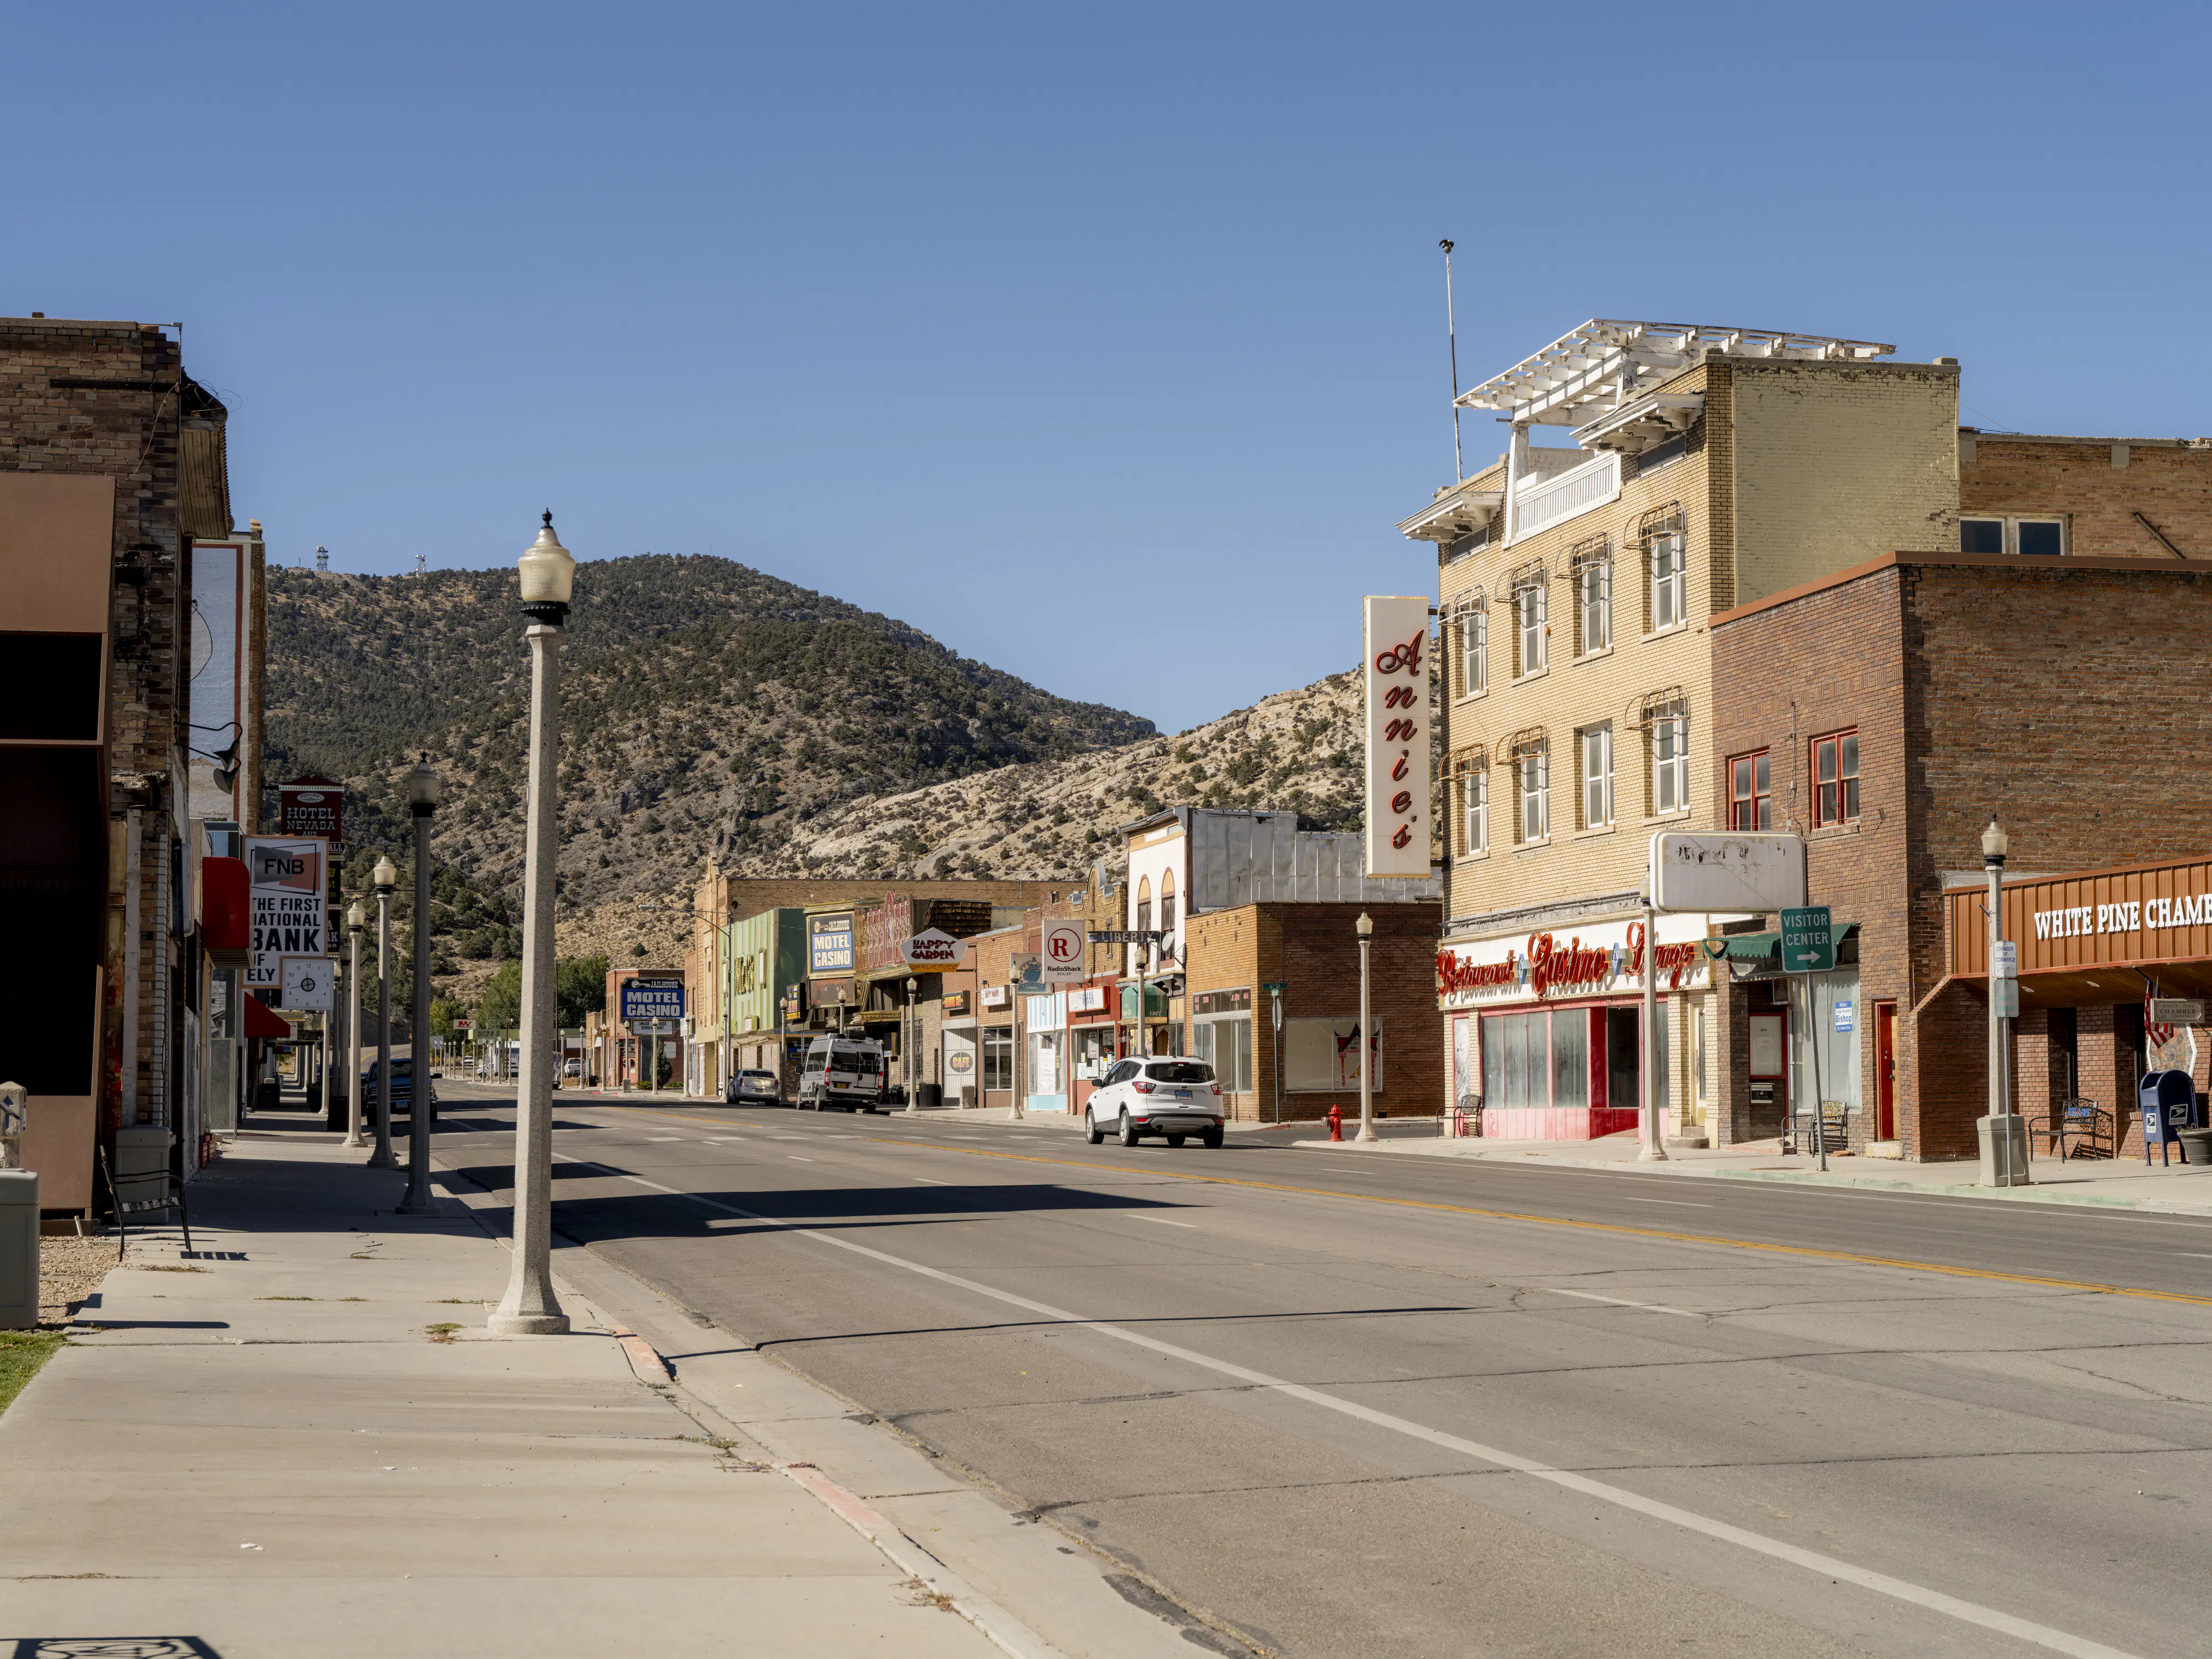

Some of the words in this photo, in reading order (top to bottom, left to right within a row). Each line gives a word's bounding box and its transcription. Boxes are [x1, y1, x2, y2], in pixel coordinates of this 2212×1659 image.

[1376, 630, 1424, 849] Annie's
[286, 807, 336, 819] HOTEL
[286, 821, 335, 830] NEVADA
[264, 858, 304, 874] FNB
[280, 898, 321, 911] FIRST
[828, 920, 850, 932] JAILHOUSE
[1783, 914, 1828, 928] VISITOR
[2034, 906, 2093, 940] WHITE
[2097, 901, 2140, 933] PINE
[813, 934, 850, 951] MOTEL
[1102, 932, 1154, 942] LIBERTY
[1786, 932, 1828, 946] CENTER
[913, 940, 956, 950] HAPPY
[815, 950, 851, 967] CASINO
[911, 950, 955, 959] GARDEN
[1438, 949, 1515, 997] Restaurant
[1528, 932, 1609, 1001] Casino
[247, 968, 275, 981] ELY
[650, 980, 679, 989] JAILHOUSE
[627, 992, 680, 1003] MOTEL
[627, 1004, 680, 1016] CASINO
[1836, 1014, 1852, 1024] Bishop
[952, 1057, 969, 1068] CAFE
[2067, 1108, 2091, 1117] WELCOME
